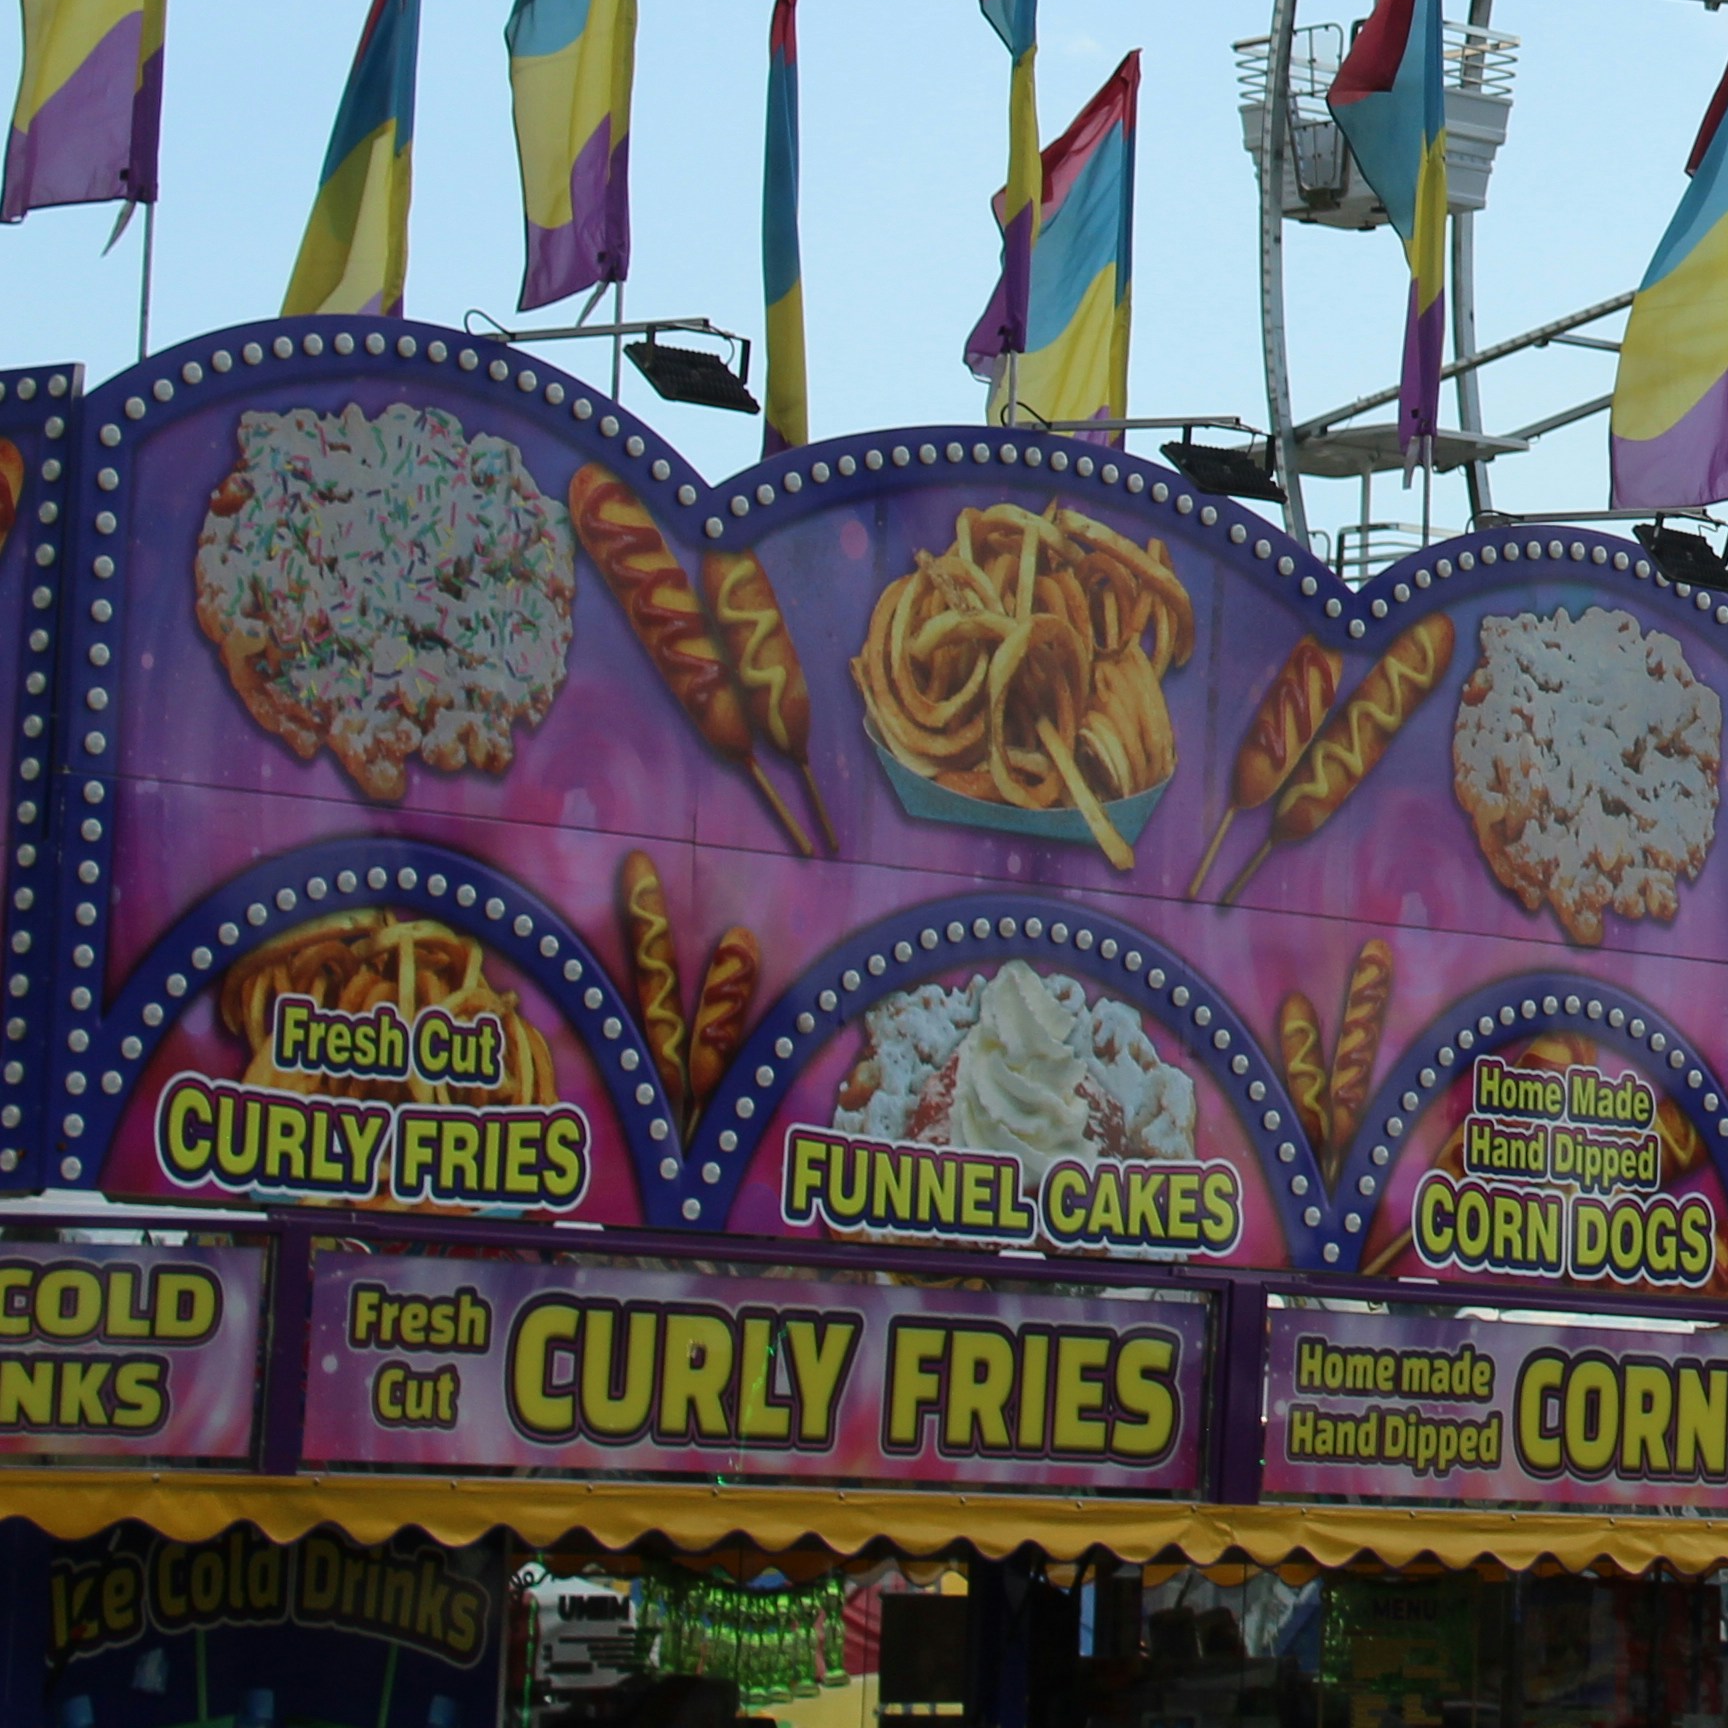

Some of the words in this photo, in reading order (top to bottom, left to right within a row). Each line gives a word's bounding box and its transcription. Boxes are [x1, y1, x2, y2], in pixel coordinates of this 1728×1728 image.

[281, 1006, 404, 1069] Fresh
[418, 1019, 497, 1080] Cut
[1479, 1065, 1563, 1116] Home
[1571, 1071, 1652, 1123] Made
[167, 1084, 389, 1188] CURLY
[402, 1111, 583, 1200] FRIES
[1470, 1126, 1546, 1173] Hand
[1554, 1134, 1657, 1188] Dipped
[791, 1138, 1029, 1232] FUNNEL
[1047, 1168, 1240, 1247] CAKES
[1419, 1181, 1559, 1264] CORN
[1574, 1198, 1712, 1275] DOGS
[0, 1267, 216, 1339] COLD
[352, 1288, 489, 1350] Fresh
[0, 1360, 163, 1428] NKS
[373, 1368, 458, 1425] Cut
[512, 1304, 857, 1442] CURLY
[888, 1326, 1177, 1461] FRIES
[1300, 1343, 1396, 1392] Home
[1401, 1349, 1492, 1397] made
[1290, 1410, 1378, 1457] Hand
[1383, 1412, 1500, 1471] Dipped
[156, 1530, 284, 1619] Cold
[301, 1535, 480, 1654] Drinks
